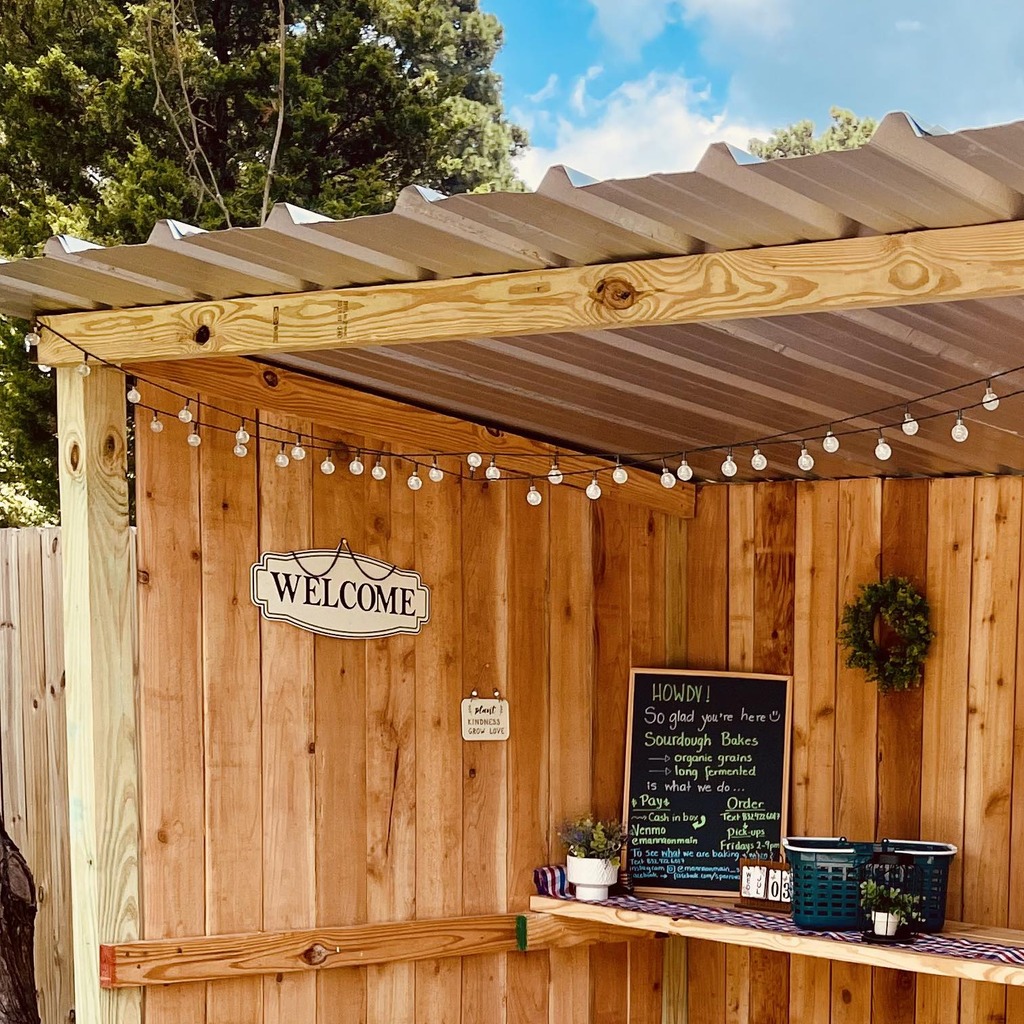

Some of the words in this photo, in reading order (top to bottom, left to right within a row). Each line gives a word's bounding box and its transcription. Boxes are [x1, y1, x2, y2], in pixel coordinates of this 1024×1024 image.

[270, 571, 416, 616] WELCOME
[652, 683, 710, 703] HOWDY!
[475, 705, 496, 715] plant
[644, 706, 665, 724] So
[669, 710, 695, 730] glad
[697, 712, 734, 732] you're
[741, 707, 766, 722] here
[644, 731, 712, 753] Sourdough
[721, 731, 759, 746] Bakes
[674, 755, 713, 767] organic
[717, 754, 753, 767] grains
[674, 764, 698, 781] long
[704, 765, 756, 781] fermented
[647, 781, 657, 791] is
[665, 780, 691, 792] what
[697, 783, 712, 793] we
[727, 796, 765, 810] Order
[648, 812, 670, 822] Cash
[672, 813, 681, 822] in
[682, 811, 699, 822] box
[720, 812, 740, 821] Text
[631, 823, 666, 836] Venmo
[726, 827, 765, 840] Pick-ups
[720, 839, 754, 854] Fridays
[630, 848, 642, 858] To
[661, 847, 681, 857] what
[712, 849, 739, 862] baking
